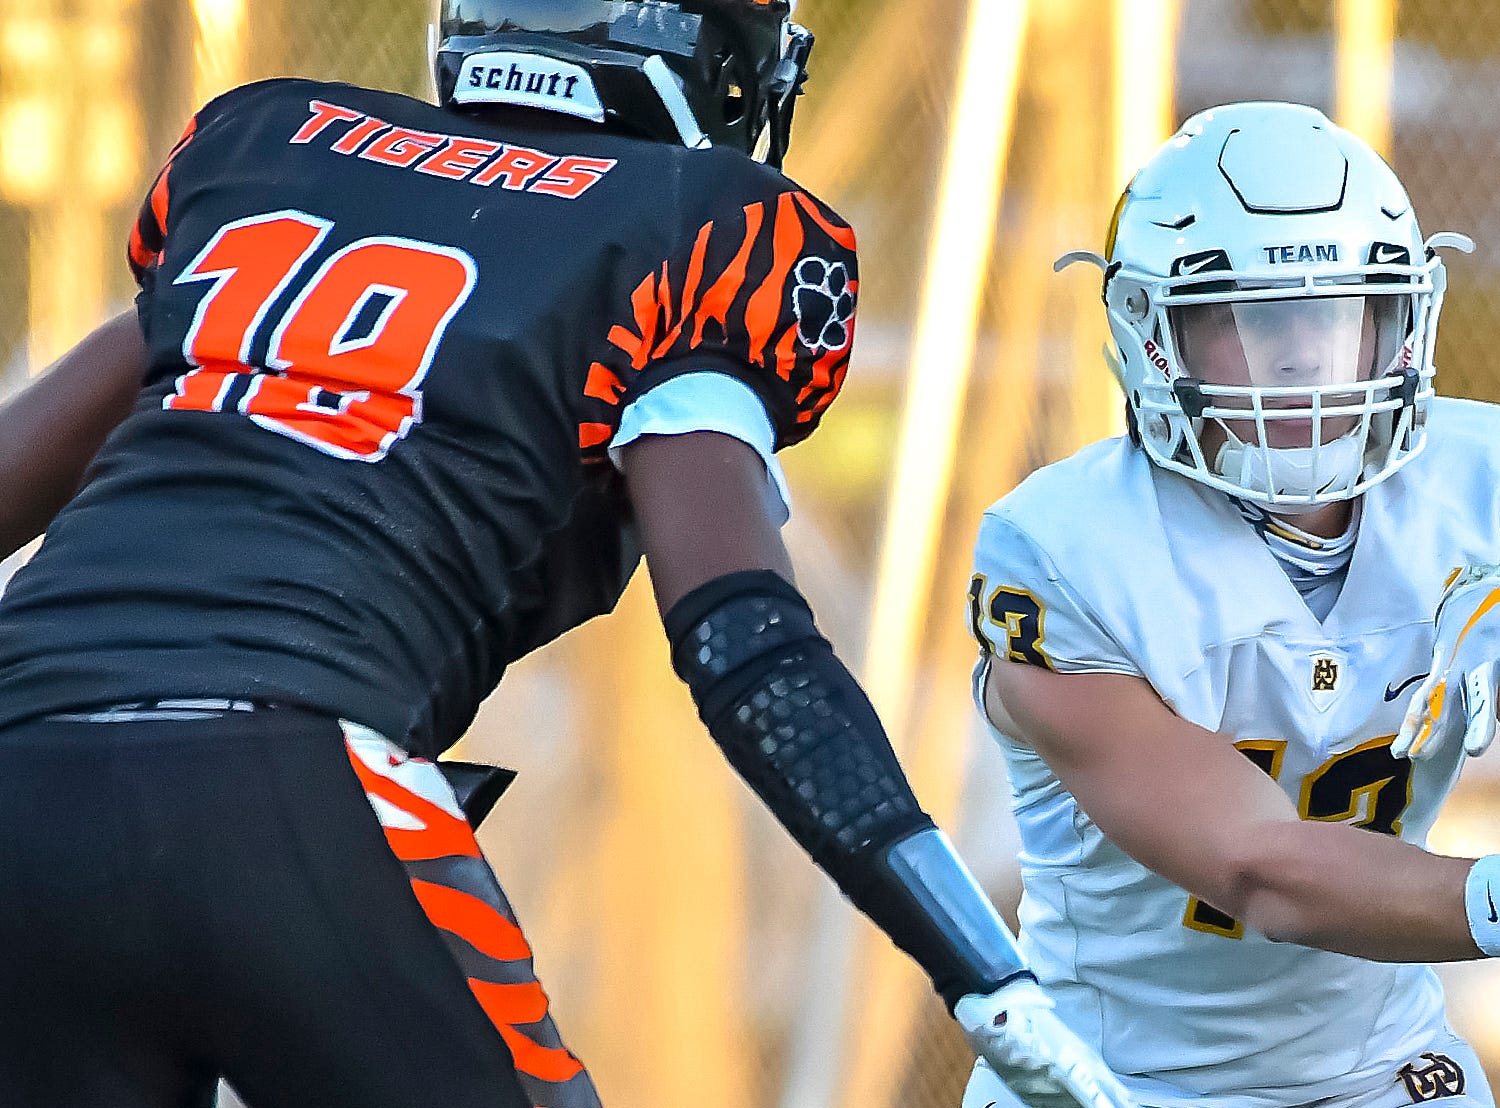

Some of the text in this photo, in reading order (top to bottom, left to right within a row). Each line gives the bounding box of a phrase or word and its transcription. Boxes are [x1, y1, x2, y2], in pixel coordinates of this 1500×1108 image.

[468, 63, 579, 99] schutt
[289, 100, 618, 200] TIGERS
[1263, 244, 1339, 265] TEAM
[968, 573, 1059, 673] 13
